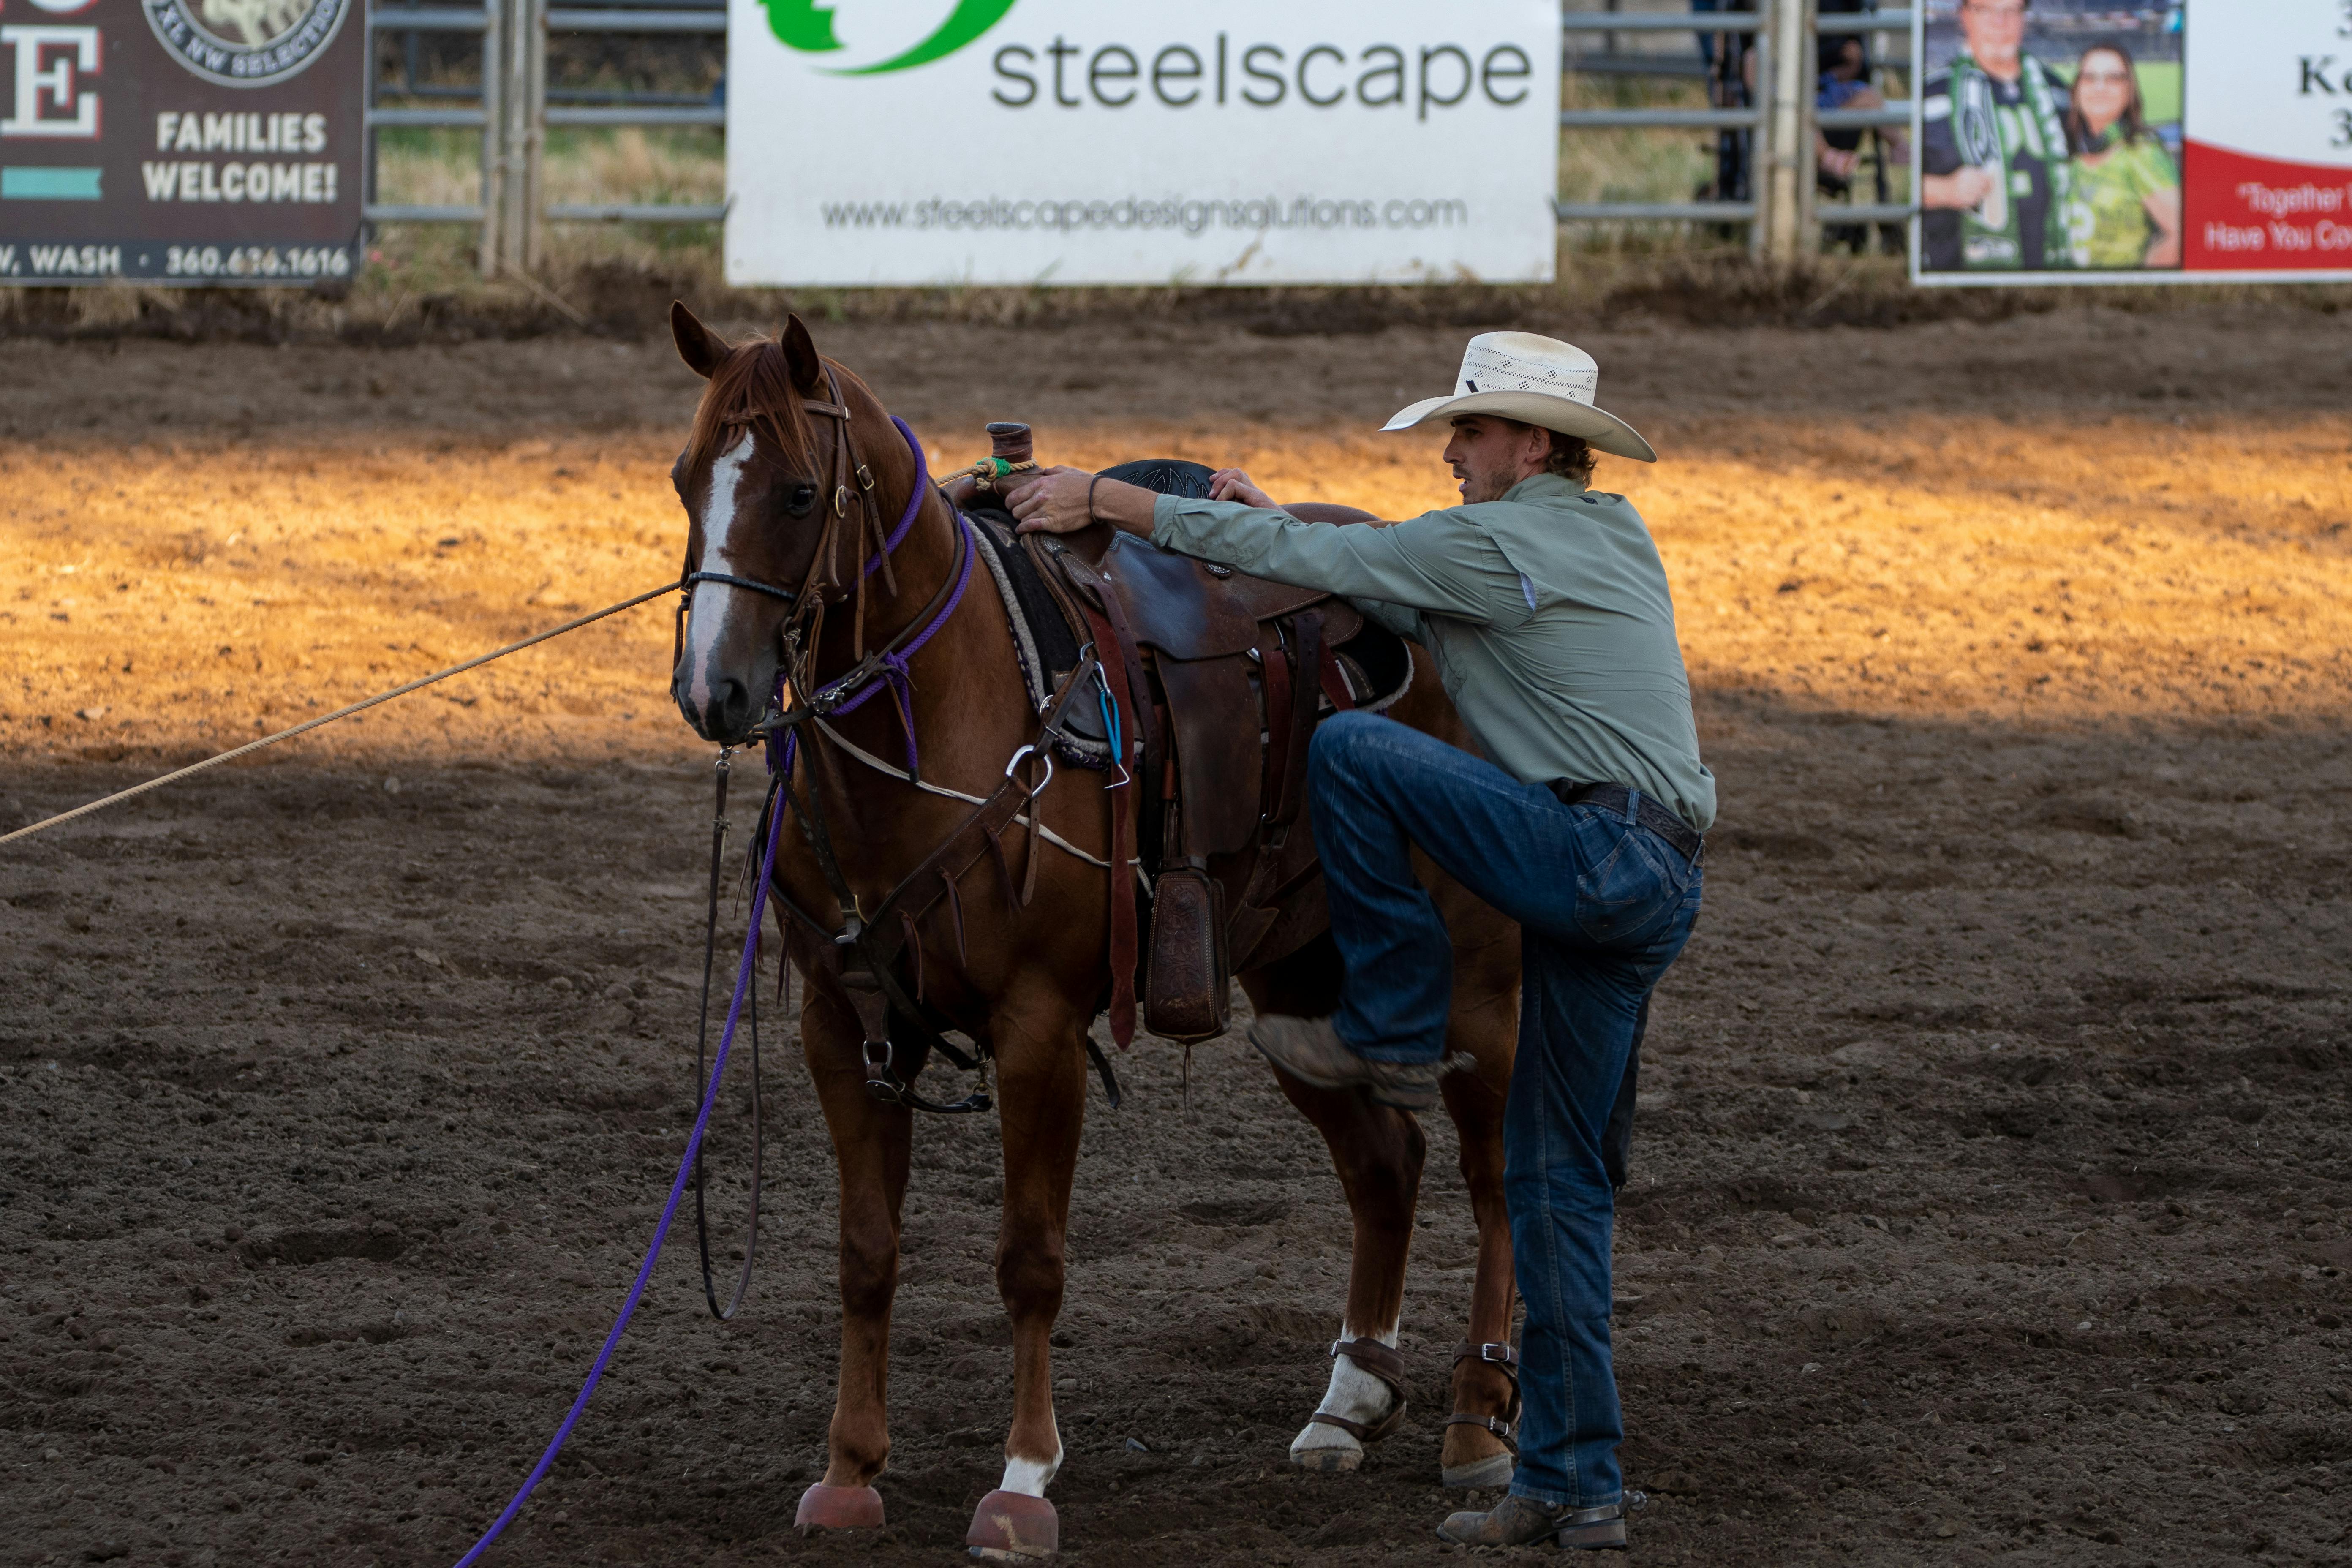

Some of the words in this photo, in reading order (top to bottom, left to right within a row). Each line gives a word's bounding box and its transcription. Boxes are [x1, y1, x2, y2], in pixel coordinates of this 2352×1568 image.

[186, 36, 228, 72] NW
[231, 0, 340, 78] SELECTIO
[991, 33, 1532, 122] steelscape
[156, 112, 327, 152] FAMILIES
[142, 162, 337, 202] WELCOME!
[821, 193, 1468, 237] www.steelscapedesignsolutions.com
[2204, 220, 2265, 251] Have
[2267, 220, 2312, 250] You
[29, 245, 122, 275] WASH
